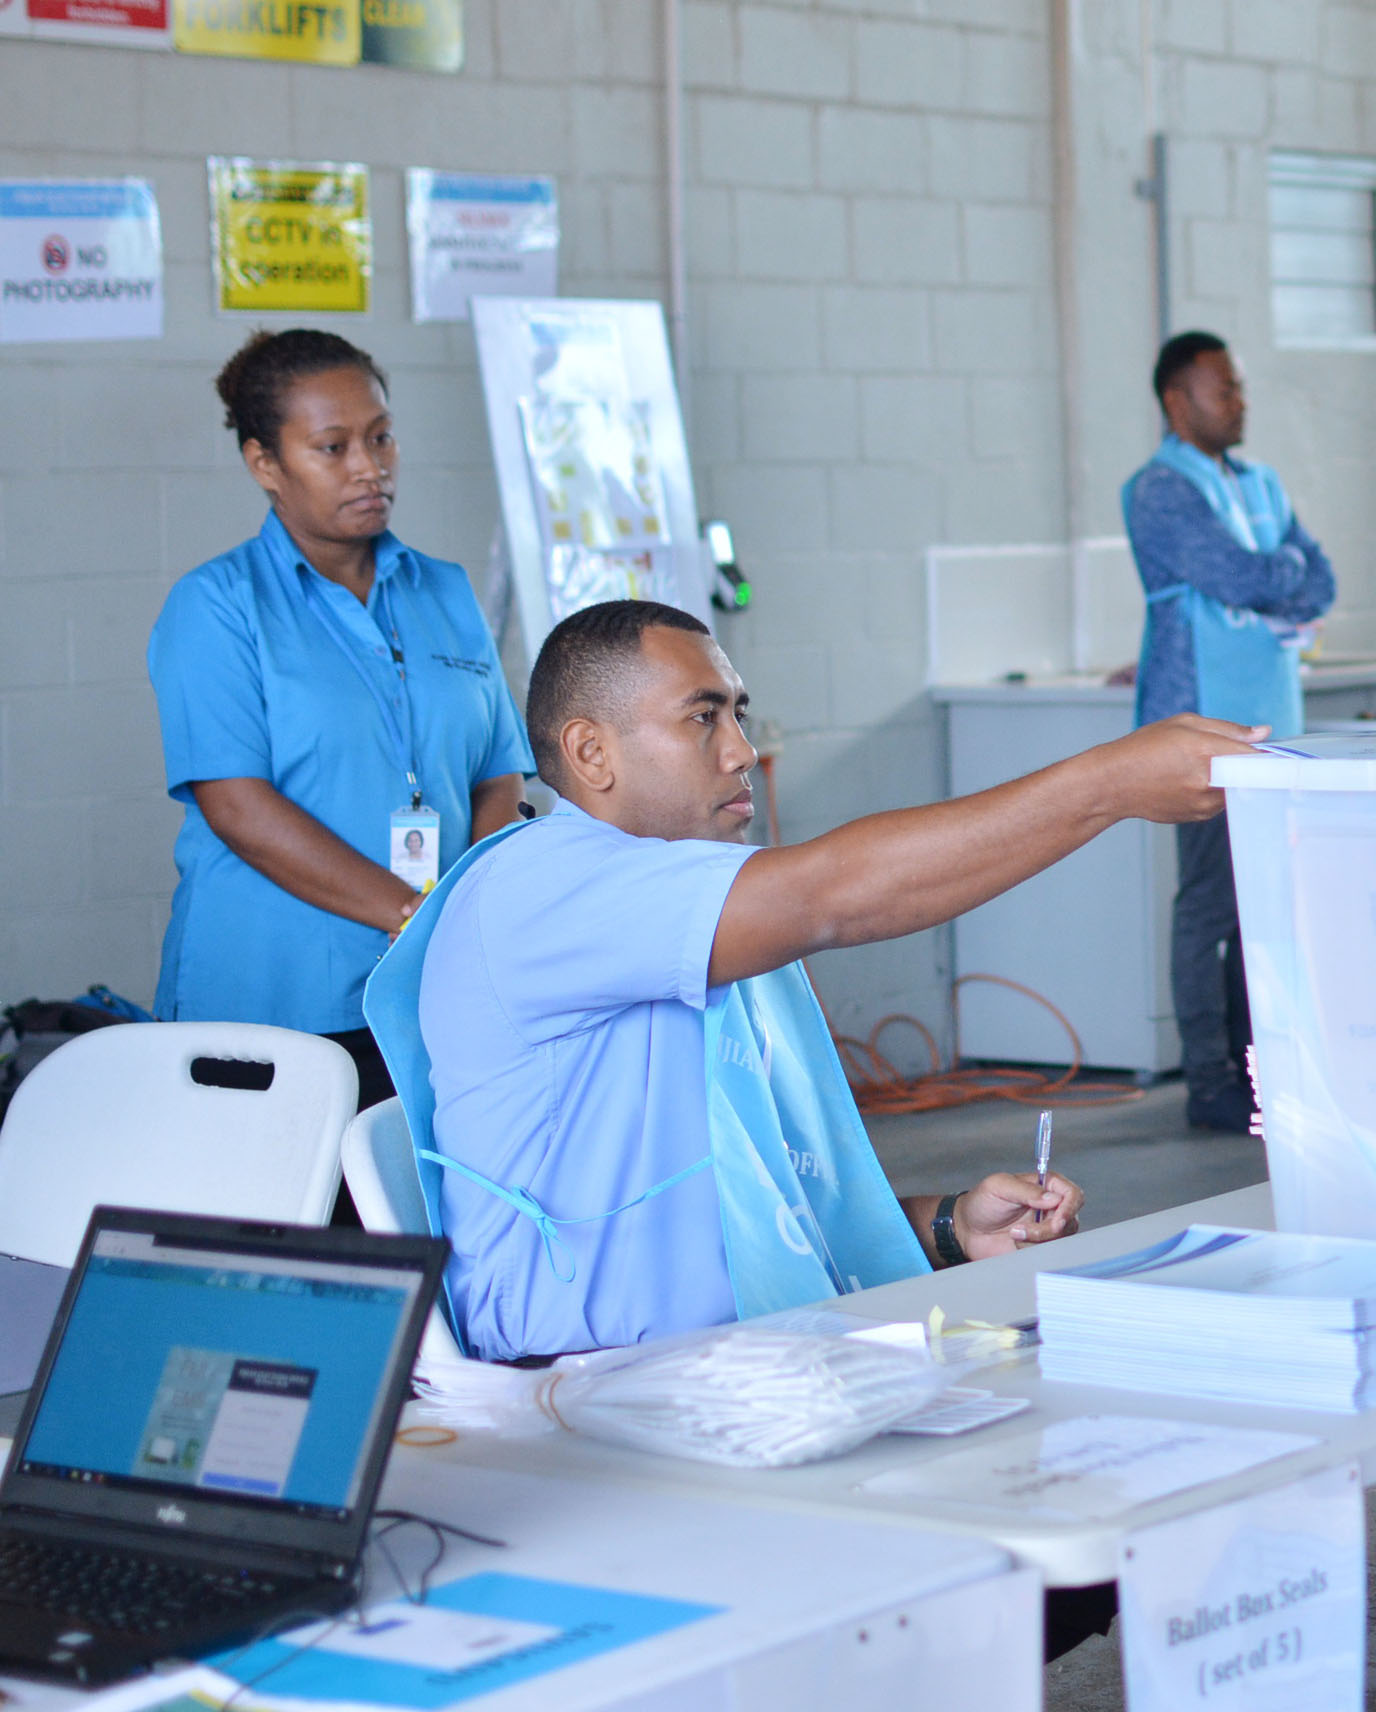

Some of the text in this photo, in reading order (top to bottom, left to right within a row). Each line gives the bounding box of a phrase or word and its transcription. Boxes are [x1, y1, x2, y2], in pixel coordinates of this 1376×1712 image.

[187, 2, 347, 41] FORKLIFTS
[246, 216, 314, 244] CCTV
[76, 247, 108, 270] NO
[239, 258, 350, 286] operation
[2, 278, 154, 302] PHOTOGRAPHY
[1167, 1568, 1329, 1647] Ballot Box Seals
[1248, 1637, 1270, 1671] of
